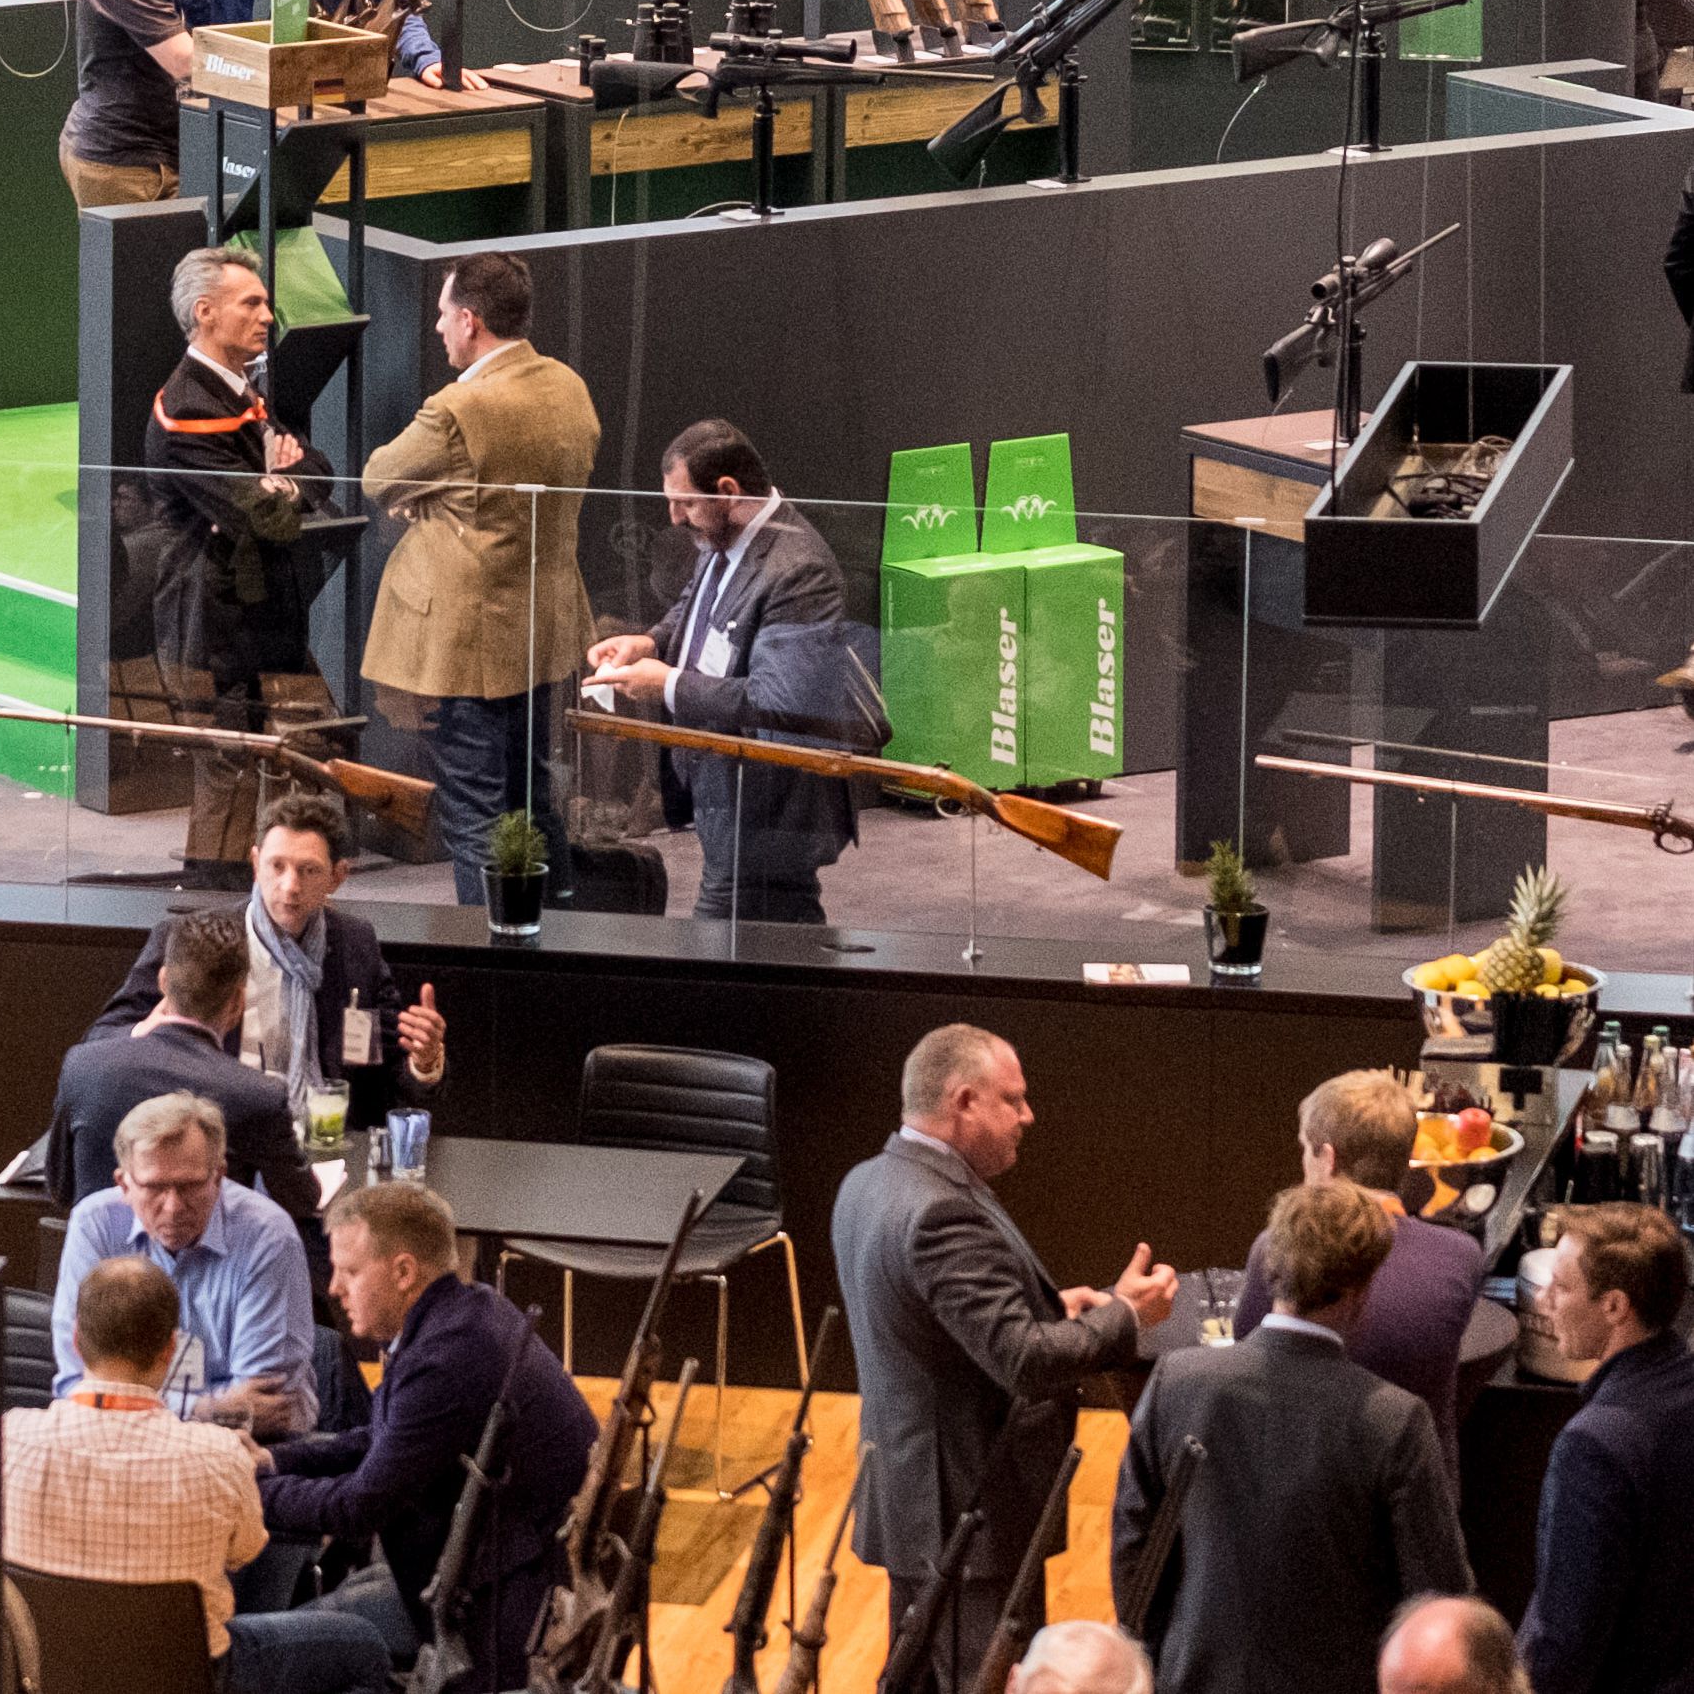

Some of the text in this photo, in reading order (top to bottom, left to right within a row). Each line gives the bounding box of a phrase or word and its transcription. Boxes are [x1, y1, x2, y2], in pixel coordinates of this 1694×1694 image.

[205, 53, 256, 82] Blaser
[991, 608, 1017, 766] Blaser
[1089, 598, 1116, 756] Blaser
